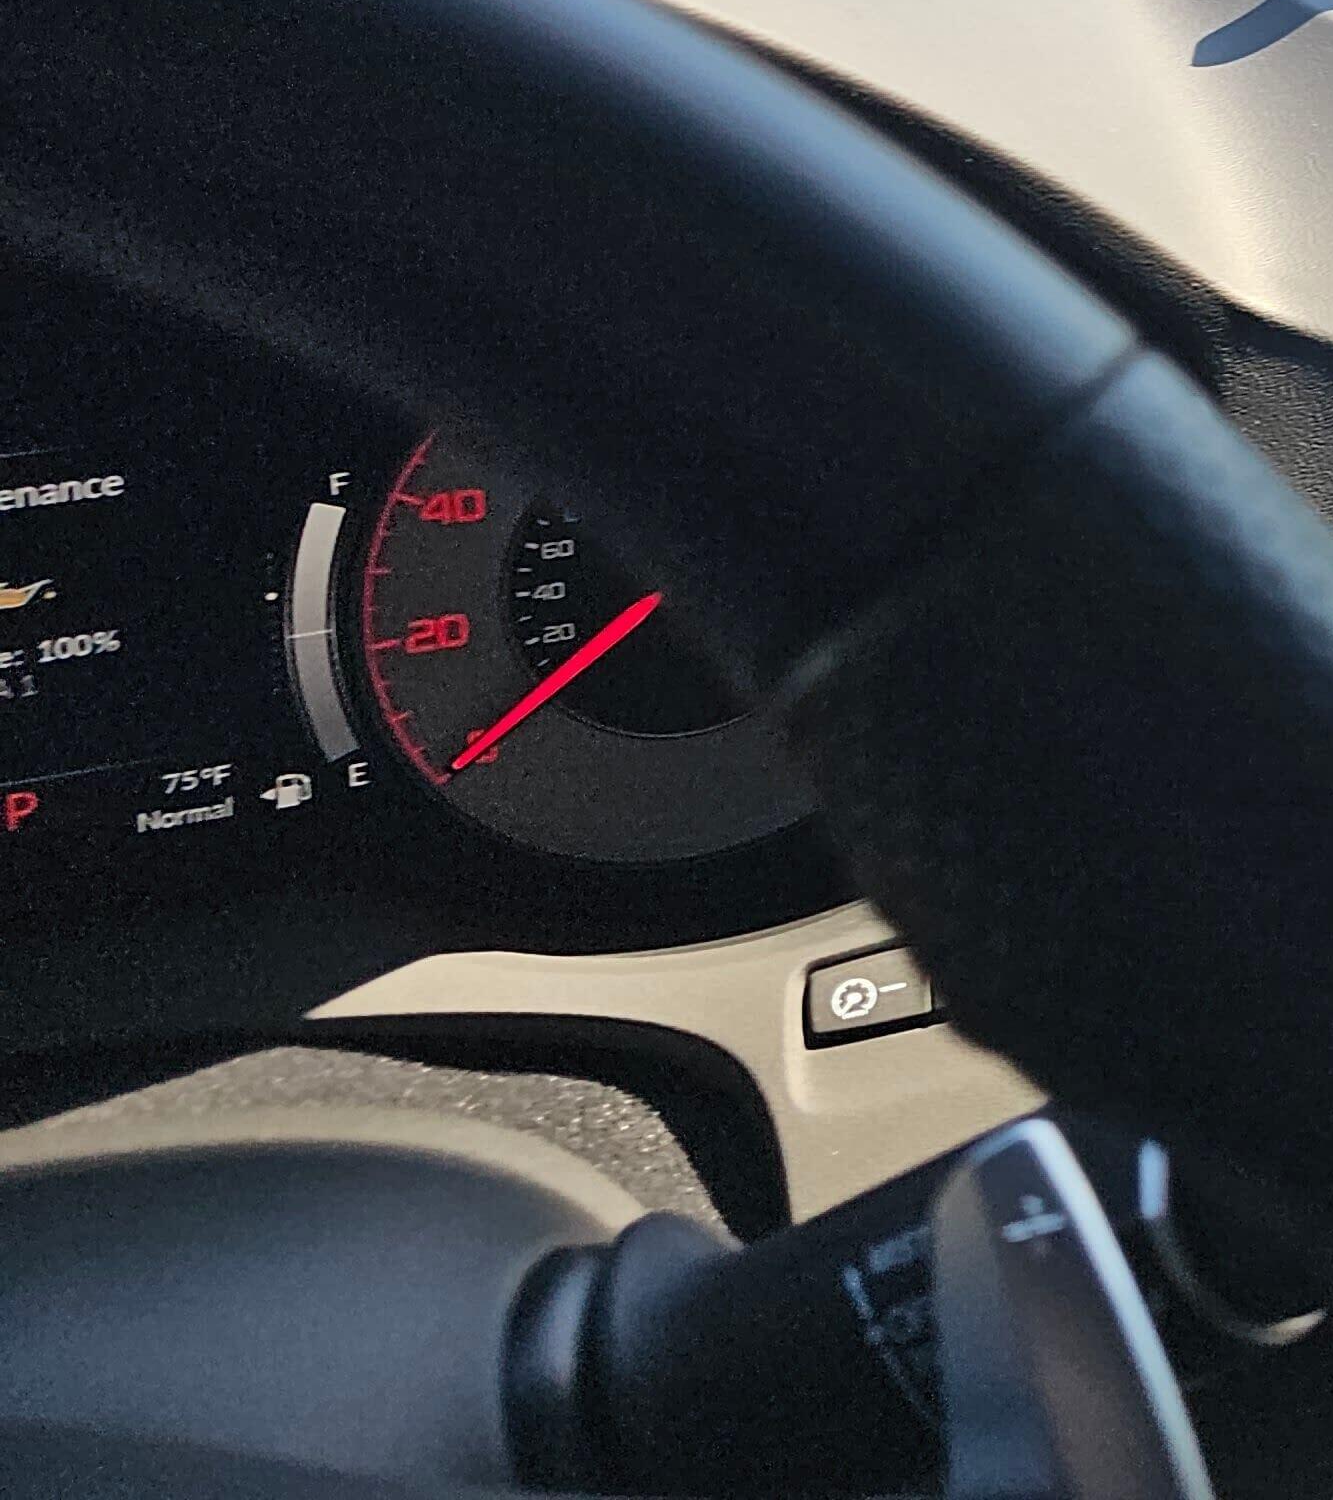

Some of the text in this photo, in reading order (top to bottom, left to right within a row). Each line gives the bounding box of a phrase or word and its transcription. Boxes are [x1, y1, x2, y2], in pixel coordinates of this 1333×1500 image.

[328, 471, 351, 496] F
[419, 488, 487, 524] 40
[541, 539, 575, 560] 60
[531, 582, 566, 601] 40
[38, 629, 121, 664] 100%
[403, 612, 471, 655] 20
[542, 623, 576, 644] 20
[348, 761, 371, 788] E
[6, 790, 39, 833] P
[135, 796, 236, 834] Normal
